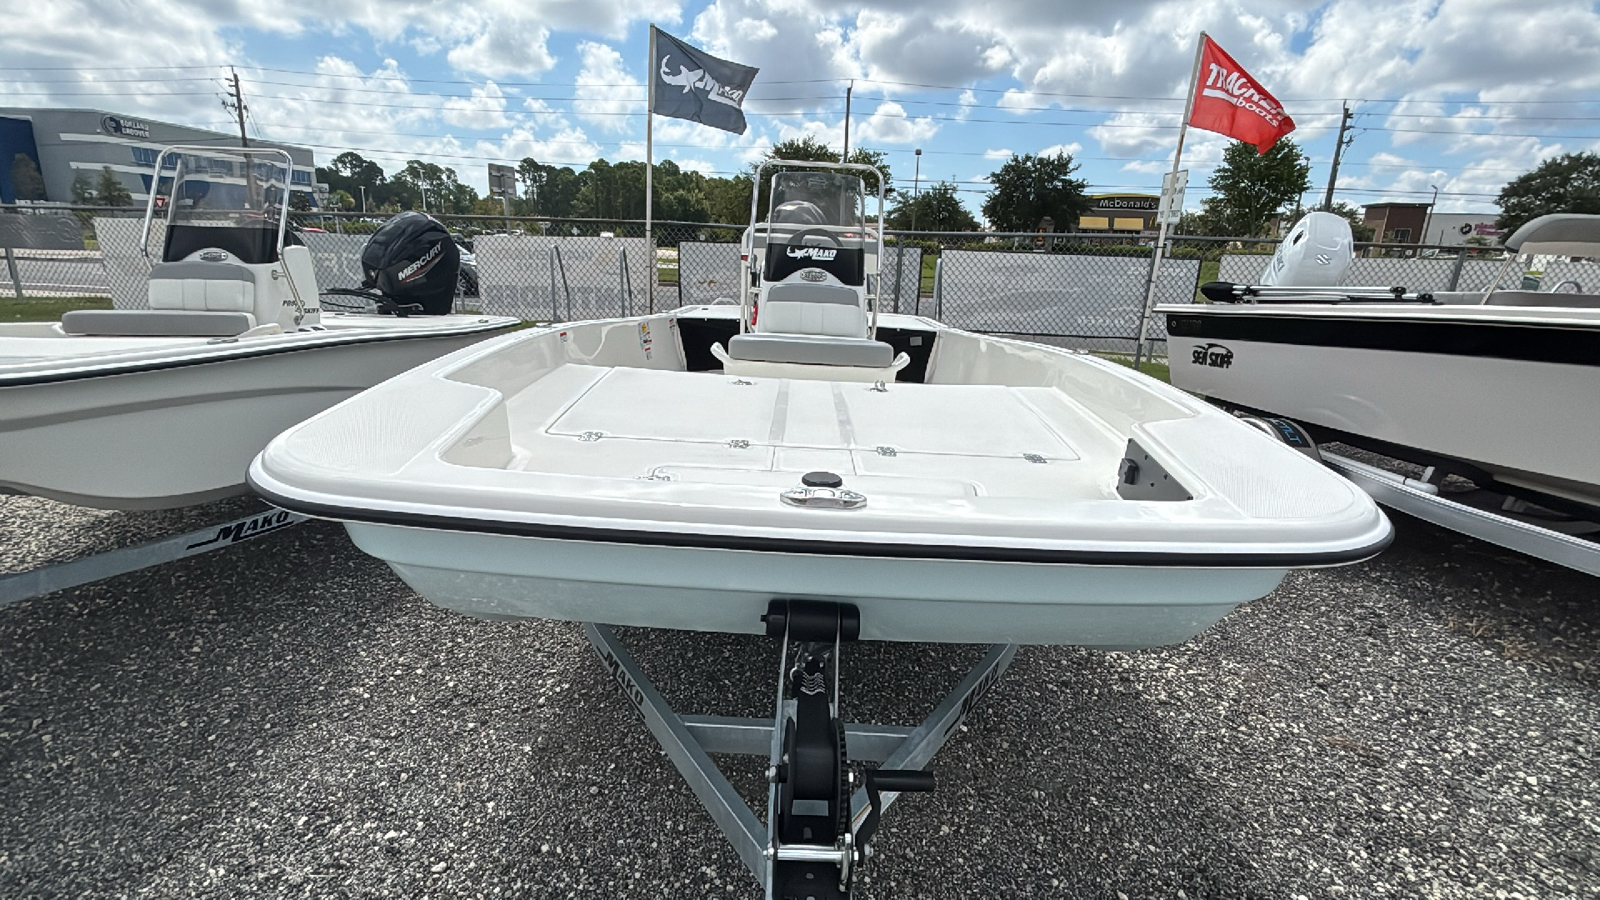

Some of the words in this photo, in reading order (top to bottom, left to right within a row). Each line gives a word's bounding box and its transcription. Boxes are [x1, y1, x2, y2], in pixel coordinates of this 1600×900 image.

[1236, 97, 1279, 128] boats
[1099, 198, 1157, 209] McDonald's
[398, 241, 441, 281] MERCURY
[803, 247, 838, 261] MAKO
[1192, 350, 1208, 366] SEA
[212, 511, 294, 543] MAKO
[600, 649, 645, 714] MAKO
